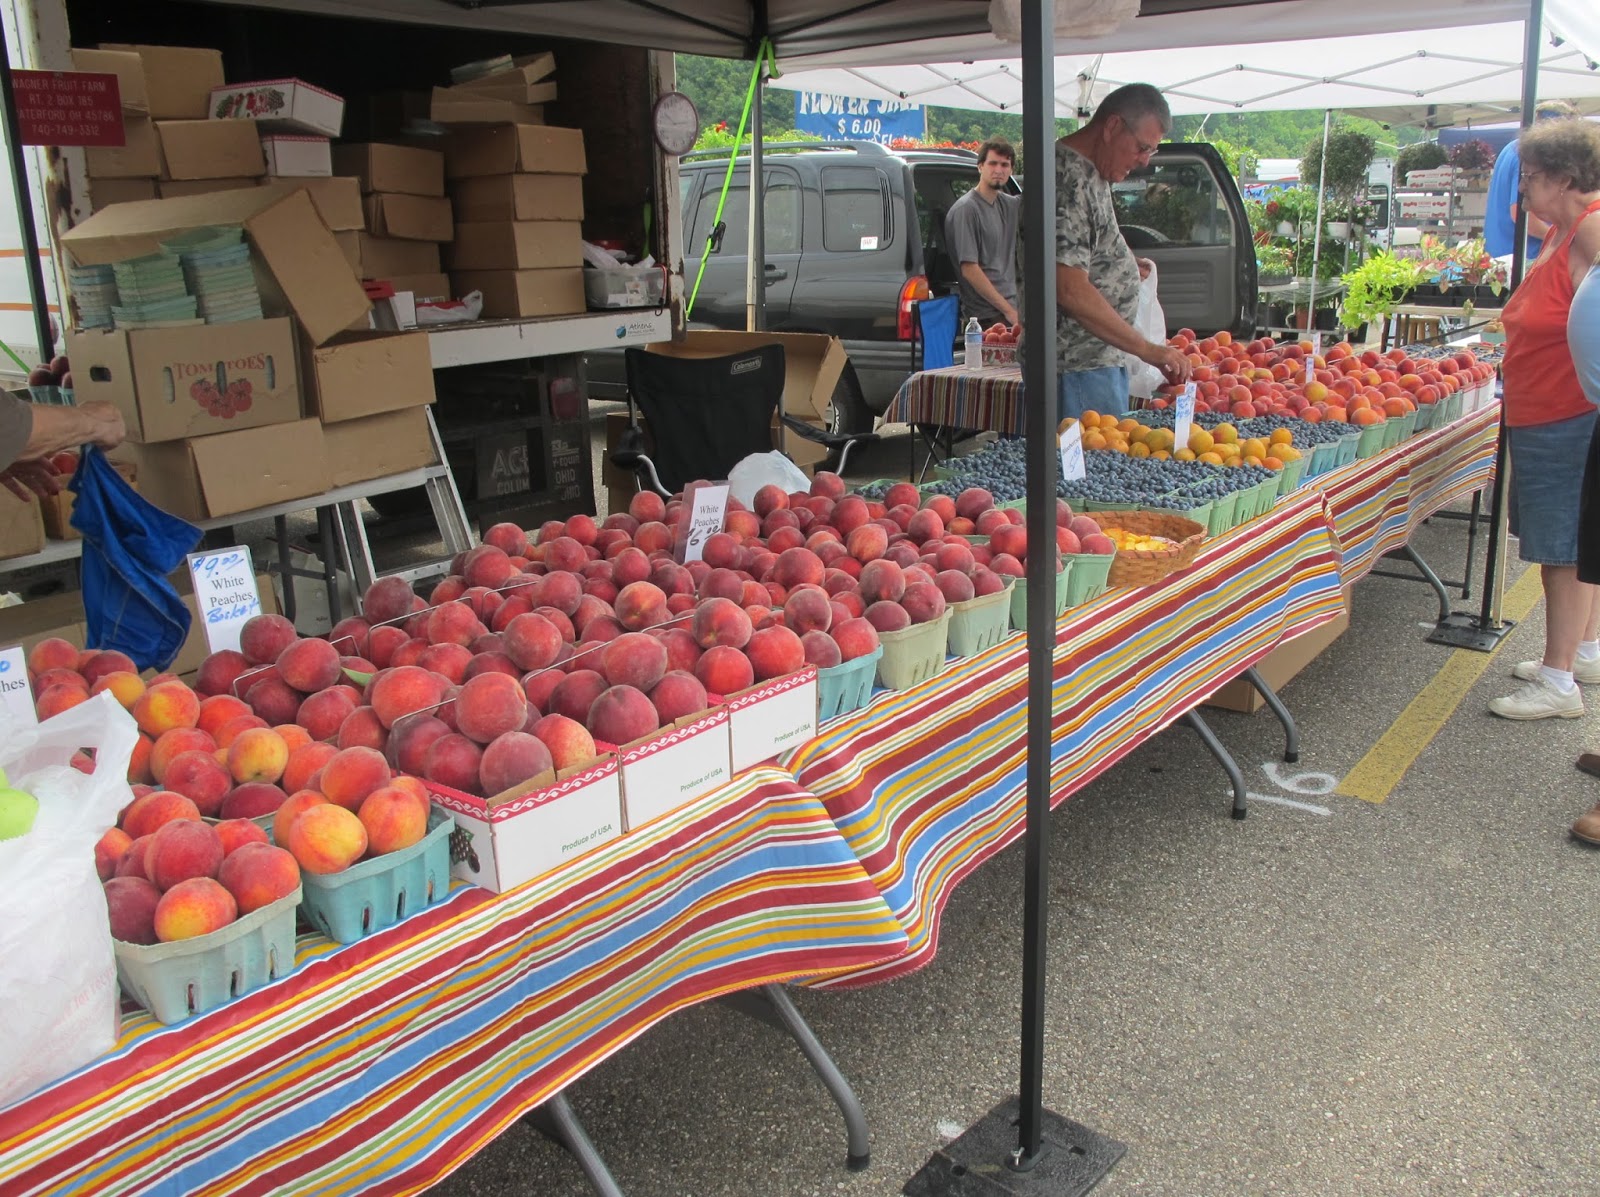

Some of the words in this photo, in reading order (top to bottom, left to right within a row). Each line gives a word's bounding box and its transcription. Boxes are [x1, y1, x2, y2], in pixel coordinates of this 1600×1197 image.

[52, 79, 77, 91] FRUIT
[82, 81, 107, 92] FARM
[47, 95, 53, 106] 2
[57, 95, 74, 106] BOX
[16, 108, 66, 121] ATERFORD
[69, 110, 82, 121] OH
[172, 352, 266, 380] TOMTOES
[496, 478, 530, 496] COLUM
[556, 469, 576, 485] OHIO
[700, 504, 719, 514] White
[694, 517, 720, 528] Peaches
[211, 576, 245, 590] White
[210, 592, 253, 608] Peaches
[774, 731, 794, 744] Produce
[800, 723, 811, 732] USA
[680, 777, 703, 792] Produce
[704, 772, 710, 781] of
[711, 767, 723, 777] USA
[561, 836, 589, 853] Produce
[590, 830, 597, 839] of
[598, 824, 612, 835] USA
